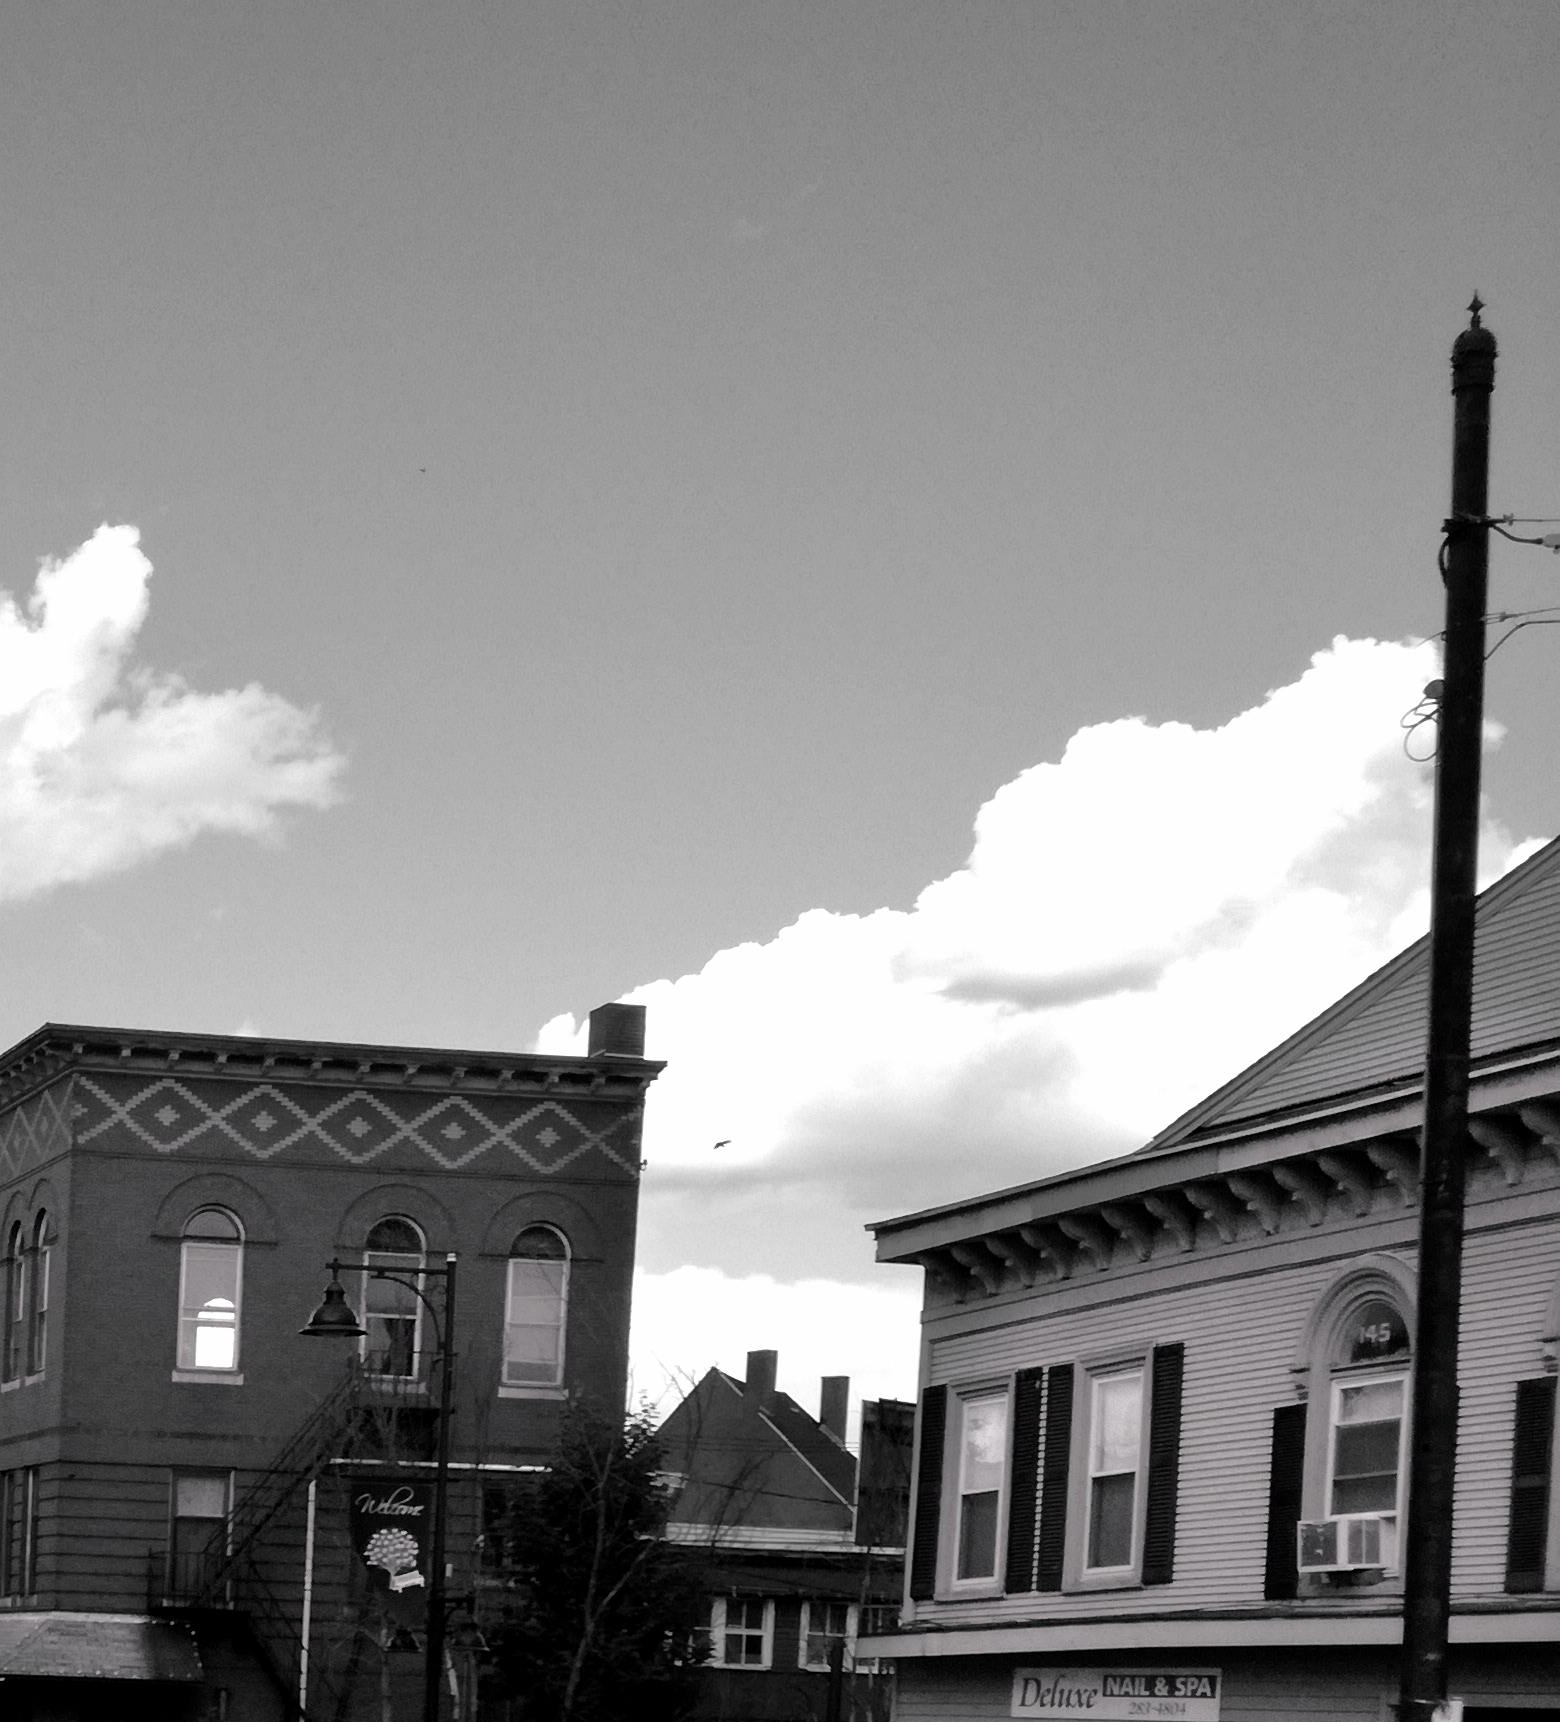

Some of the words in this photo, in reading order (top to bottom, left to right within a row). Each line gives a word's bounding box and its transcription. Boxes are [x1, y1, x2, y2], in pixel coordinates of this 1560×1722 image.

[1018, 1675, 1098, 1709] Deluxe
[1106, 1676, 1150, 1697] NAIL
[1154, 1677, 1168, 1696] &
[1174, 1677, 1212, 1697] SPA
